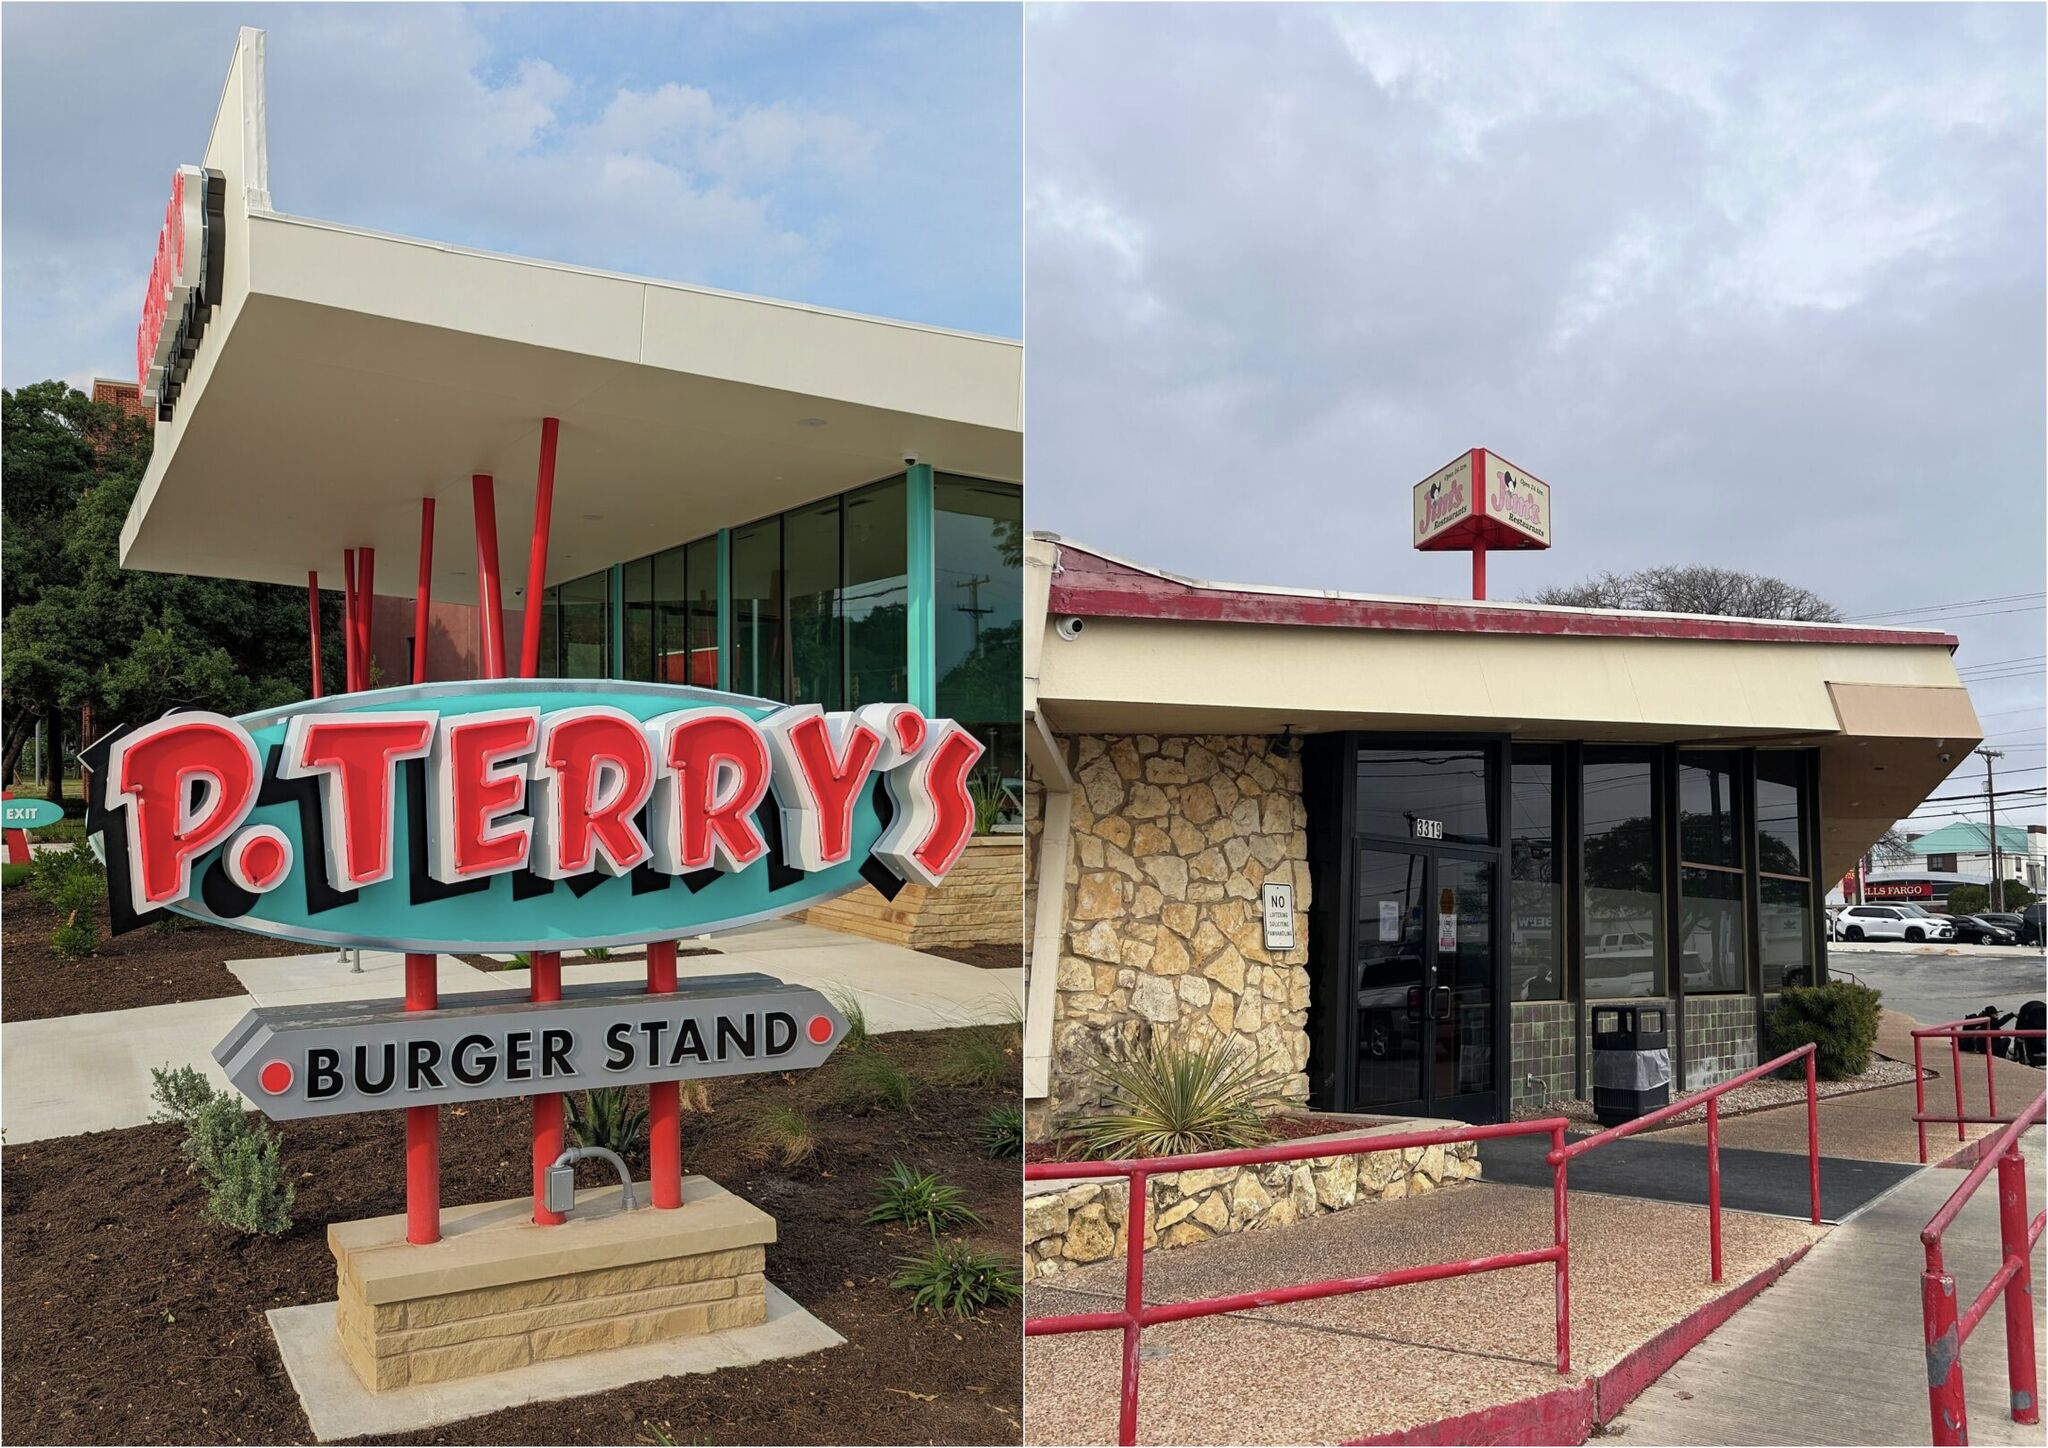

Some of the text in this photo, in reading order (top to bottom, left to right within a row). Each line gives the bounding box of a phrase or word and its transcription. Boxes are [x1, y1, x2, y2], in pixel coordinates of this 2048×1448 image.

[1490, 471, 1541, 525] Jim's
[1433, 505, 1468, 530] Restaurants
[1508, 512, 1545, 537] Restaurants
[6, 808, 38, 819] EXIT
[1417, 820, 1442, 838] 3319
[1888, 885, 1922, 895] FARGO
[1271, 895, 1285, 909] NO
[305, 1010, 801, 1099] BURGER STAND
